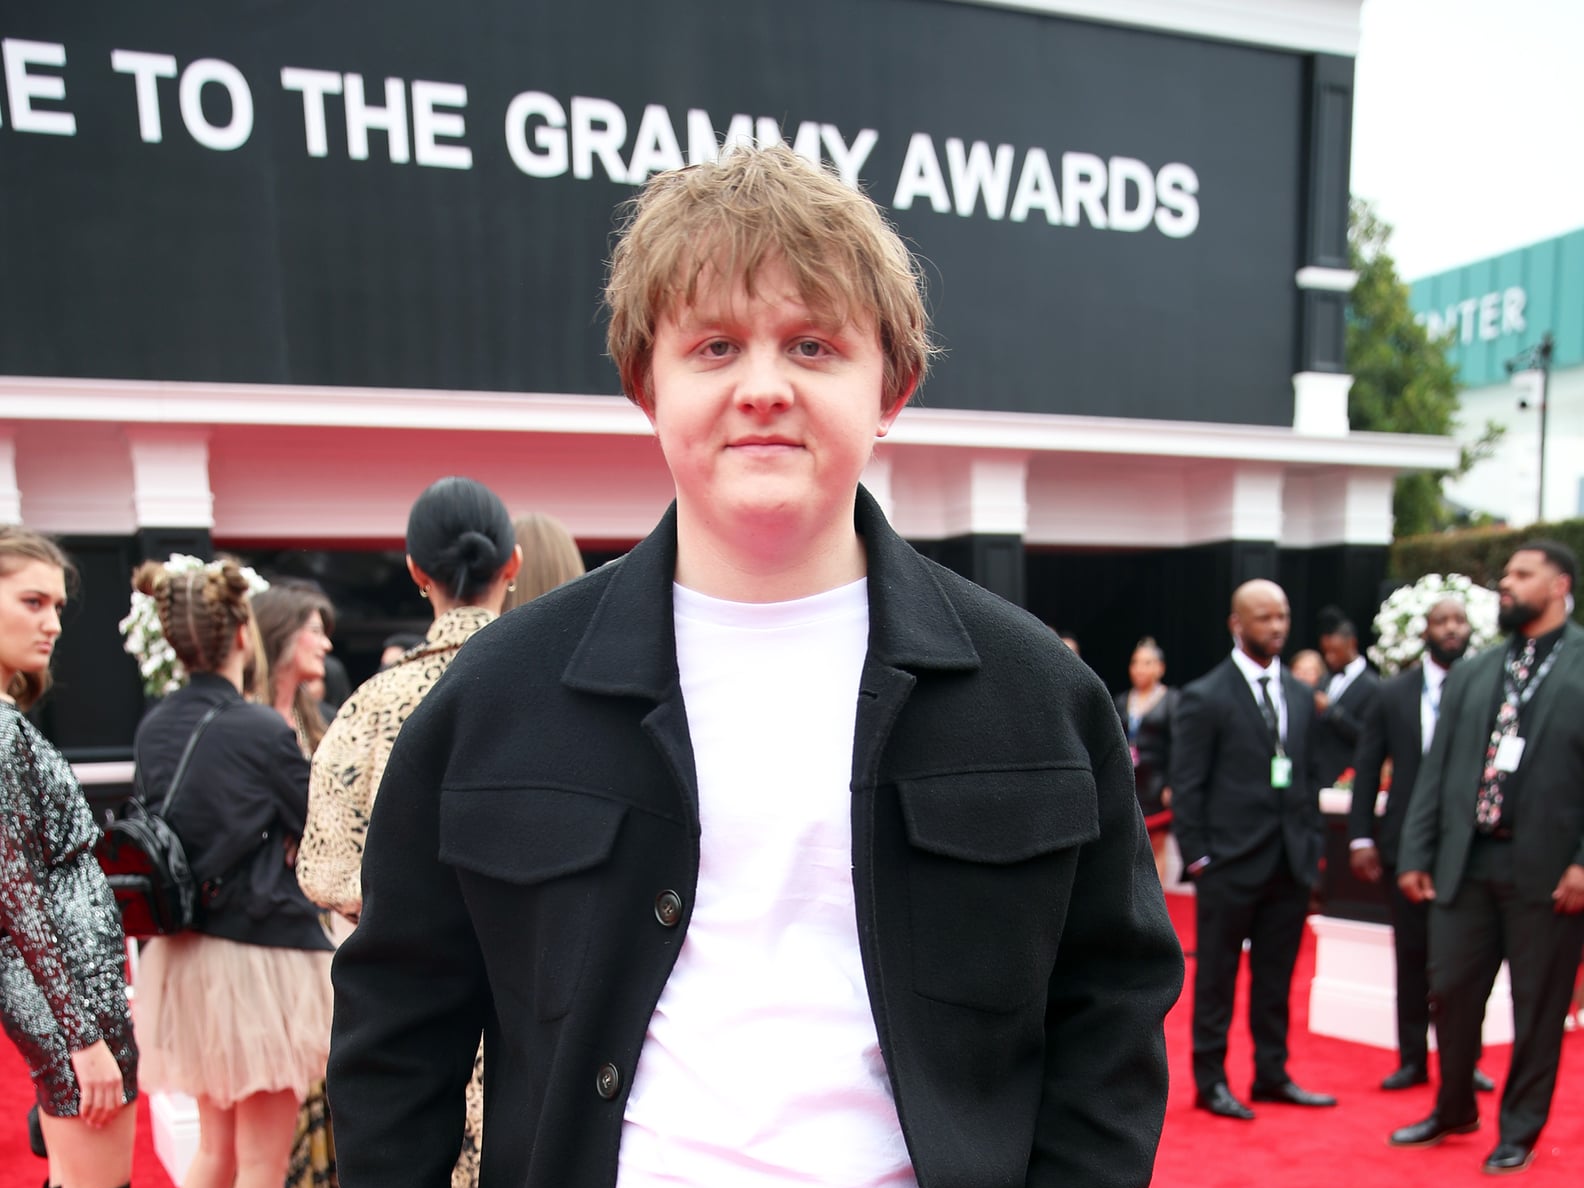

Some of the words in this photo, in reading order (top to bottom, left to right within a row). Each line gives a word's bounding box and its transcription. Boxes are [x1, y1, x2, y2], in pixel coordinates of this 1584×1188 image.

[0, 38, 77, 136] E
[111, 49, 254, 151] TO
[280, 66, 473, 170] THE
[893, 132, 1200, 239] AWARDS
[1413, 286, 1527, 345] NTER
